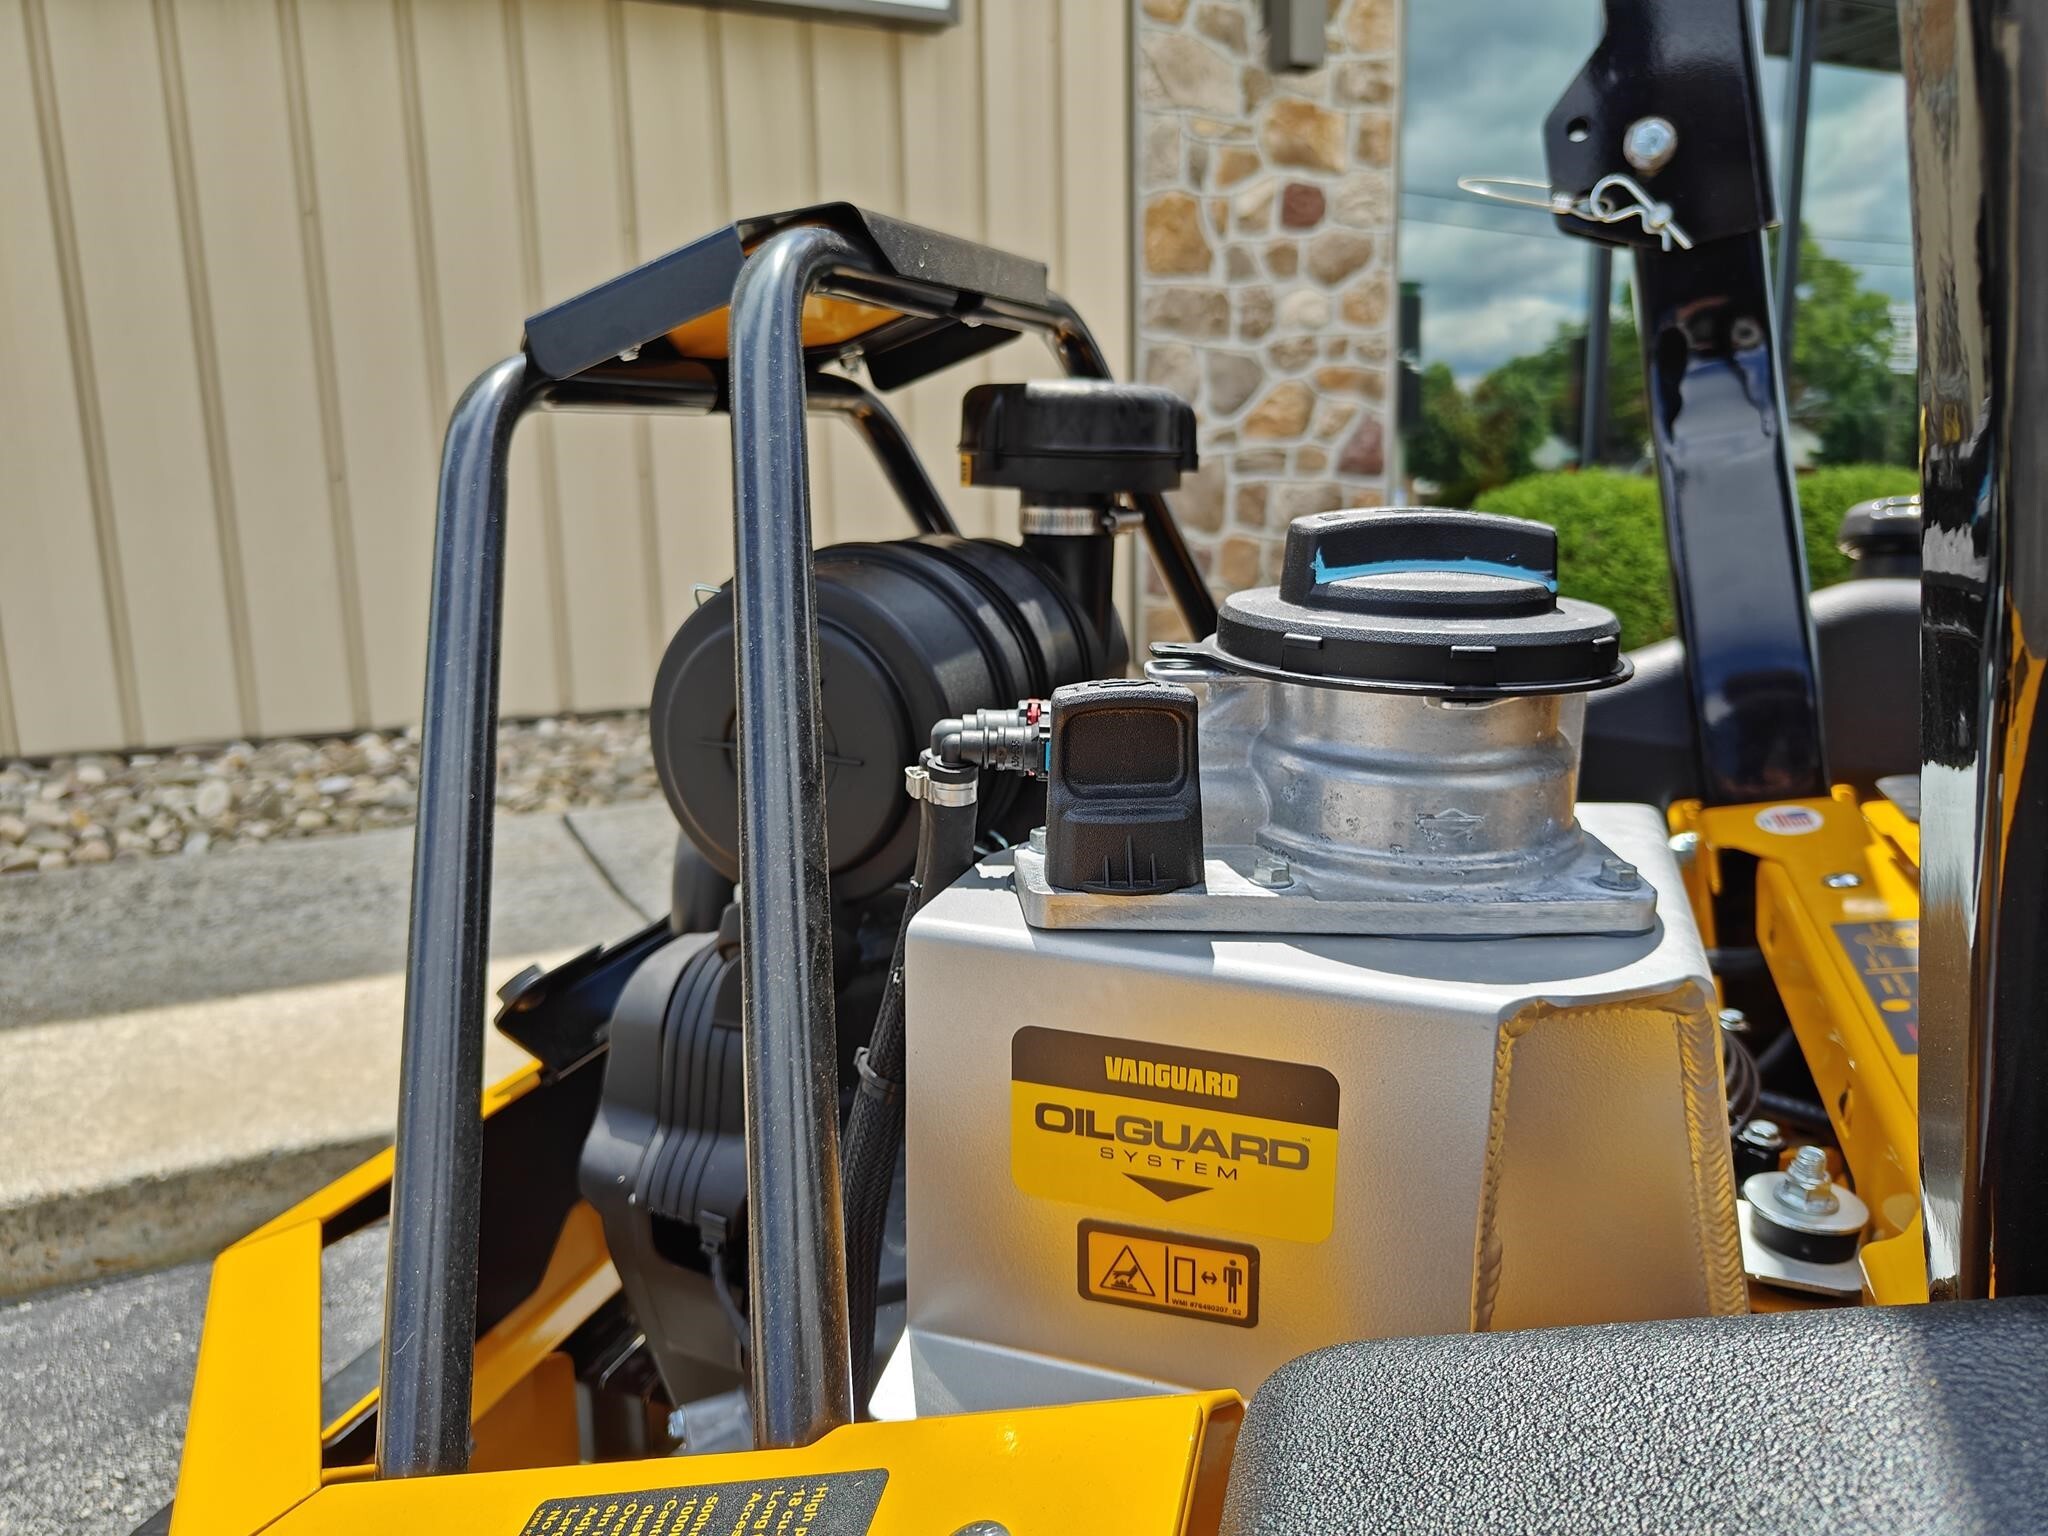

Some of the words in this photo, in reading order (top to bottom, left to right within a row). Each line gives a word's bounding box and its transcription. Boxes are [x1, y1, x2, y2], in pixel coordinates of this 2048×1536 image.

[1105, 1055, 1239, 1099] VANGUARD
[1100, 1146, 1237, 1181] SYSTEM
[753, 1489, 785, 1530] Long
[788, 1490, 806, 1507] 18
[801, 1485, 829, 1522] High
[541, 1509, 562, 1531] No
[776, 1509, 793, 1536] cu-
